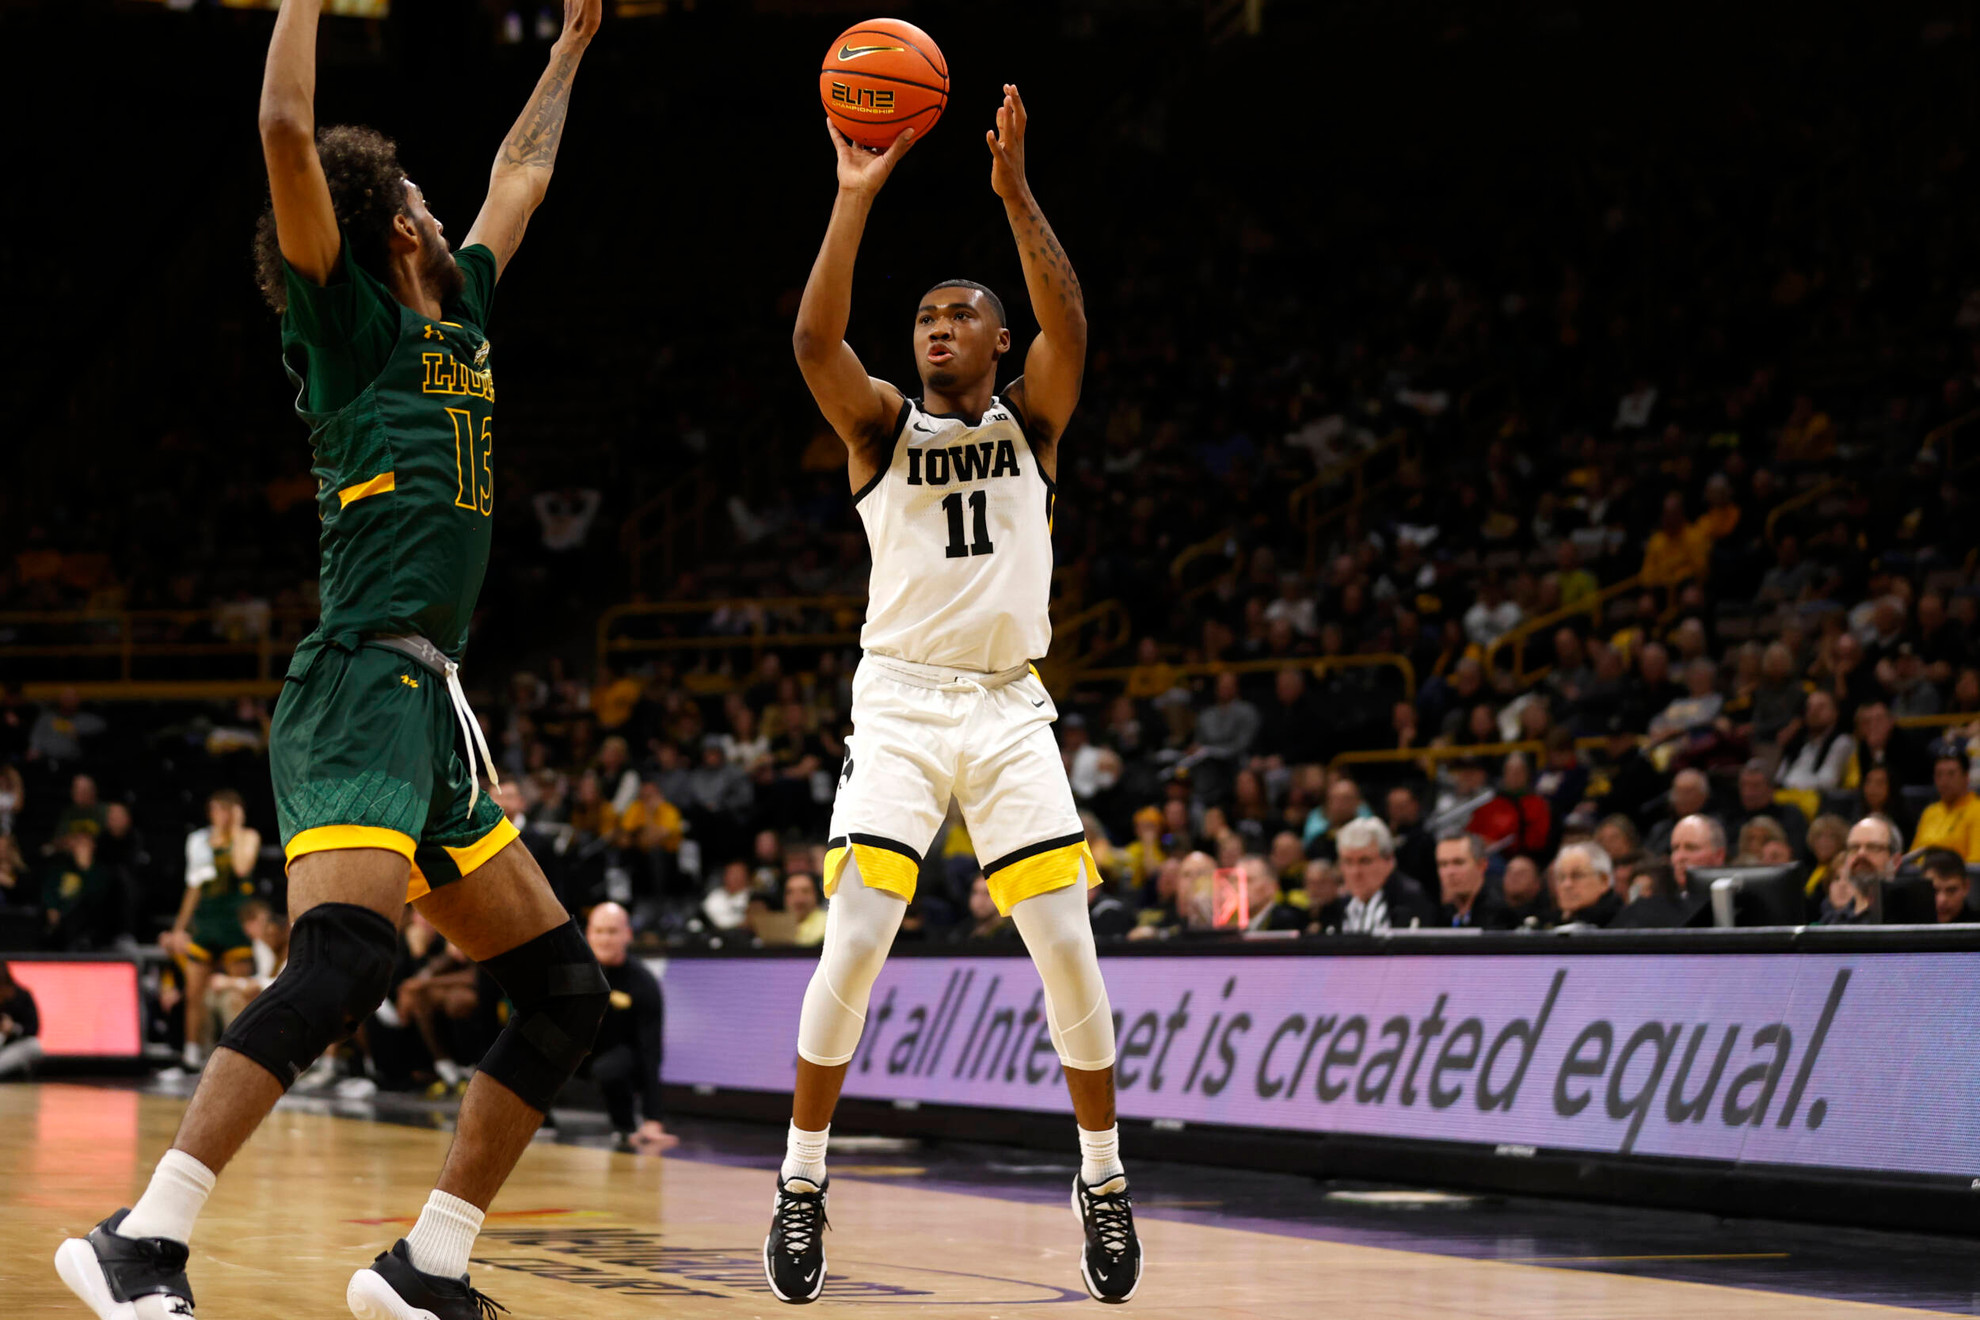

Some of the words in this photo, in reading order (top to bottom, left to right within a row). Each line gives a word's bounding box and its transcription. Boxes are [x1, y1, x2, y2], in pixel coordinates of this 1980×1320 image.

[831, 100, 895, 115] CHAMPIONSHIP
[832, 81, 895, 108] ELITE
[907, 440, 1020, 485] IOWA
[942, 490, 993, 558] 11
[887, 969, 975, 1077] all
[953, 976, 1194, 1092] Inteet
[1183, 975, 1252, 1097] is
[1255, 969, 1567, 1111] created
[1552, 968, 1853, 1154] equal.
